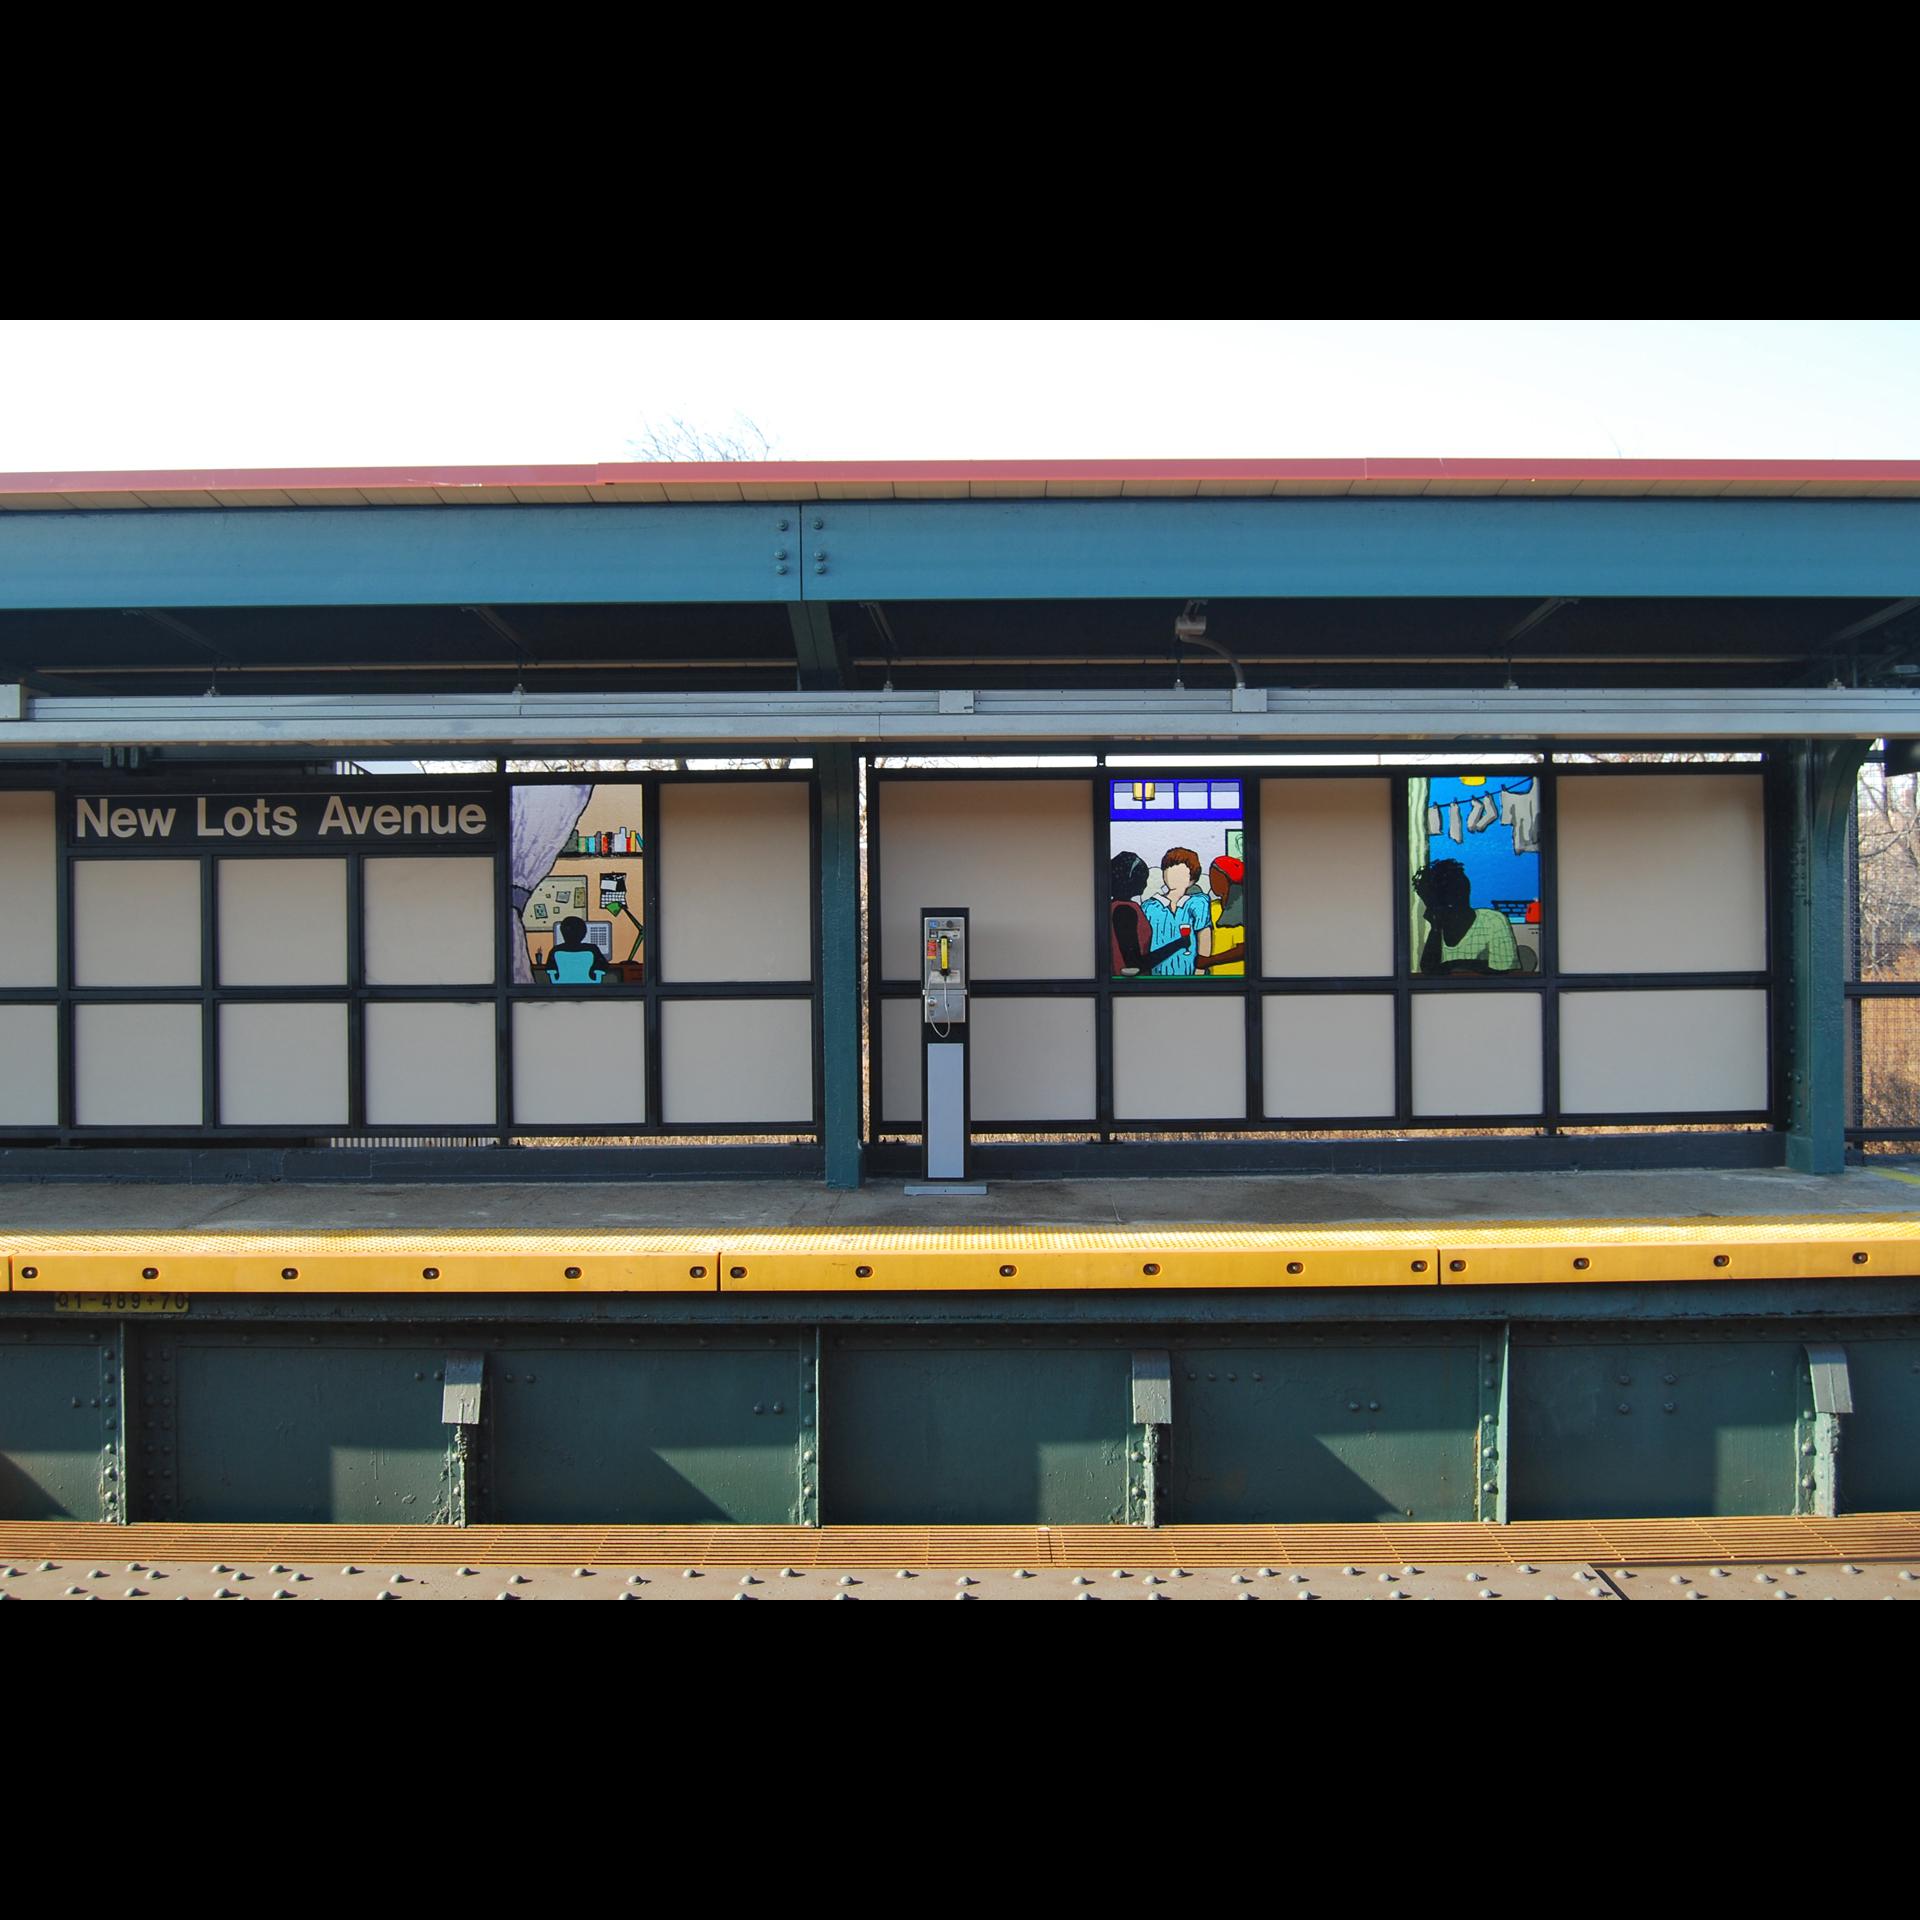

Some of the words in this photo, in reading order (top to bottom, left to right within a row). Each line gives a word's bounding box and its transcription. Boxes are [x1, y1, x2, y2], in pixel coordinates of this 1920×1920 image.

[76, 798, 175, 838] New
[197, 797, 298, 837] Lots
[318, 795, 487, 835] Avenue
